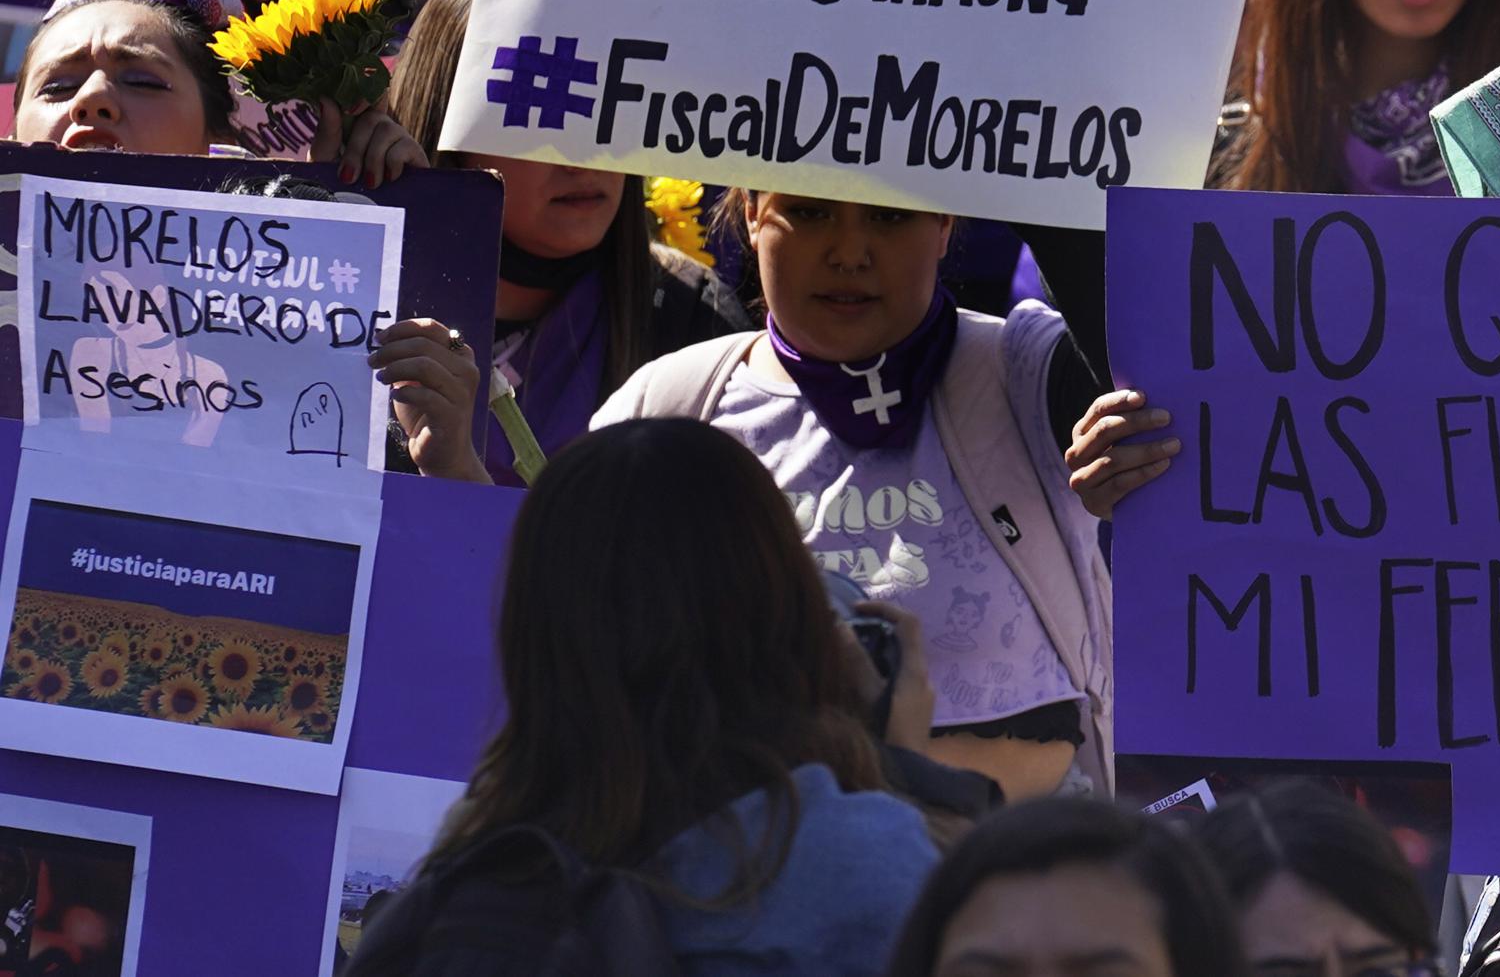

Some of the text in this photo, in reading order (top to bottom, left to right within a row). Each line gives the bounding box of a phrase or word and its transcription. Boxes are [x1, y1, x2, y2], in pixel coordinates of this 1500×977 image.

[44, 190, 290, 277] MORELOS
[38, 280, 392, 354] LAVADERO DE
[1190, 210, 1387, 381] NO
[301, 394, 328, 428] RIP
[1199, 395, 1388, 538] LAS
[71, 547, 275, 595] #justiciaparaARI
[1186, 573, 1320, 697] MI
[1153, 790, 1189, 812] BUSCA
